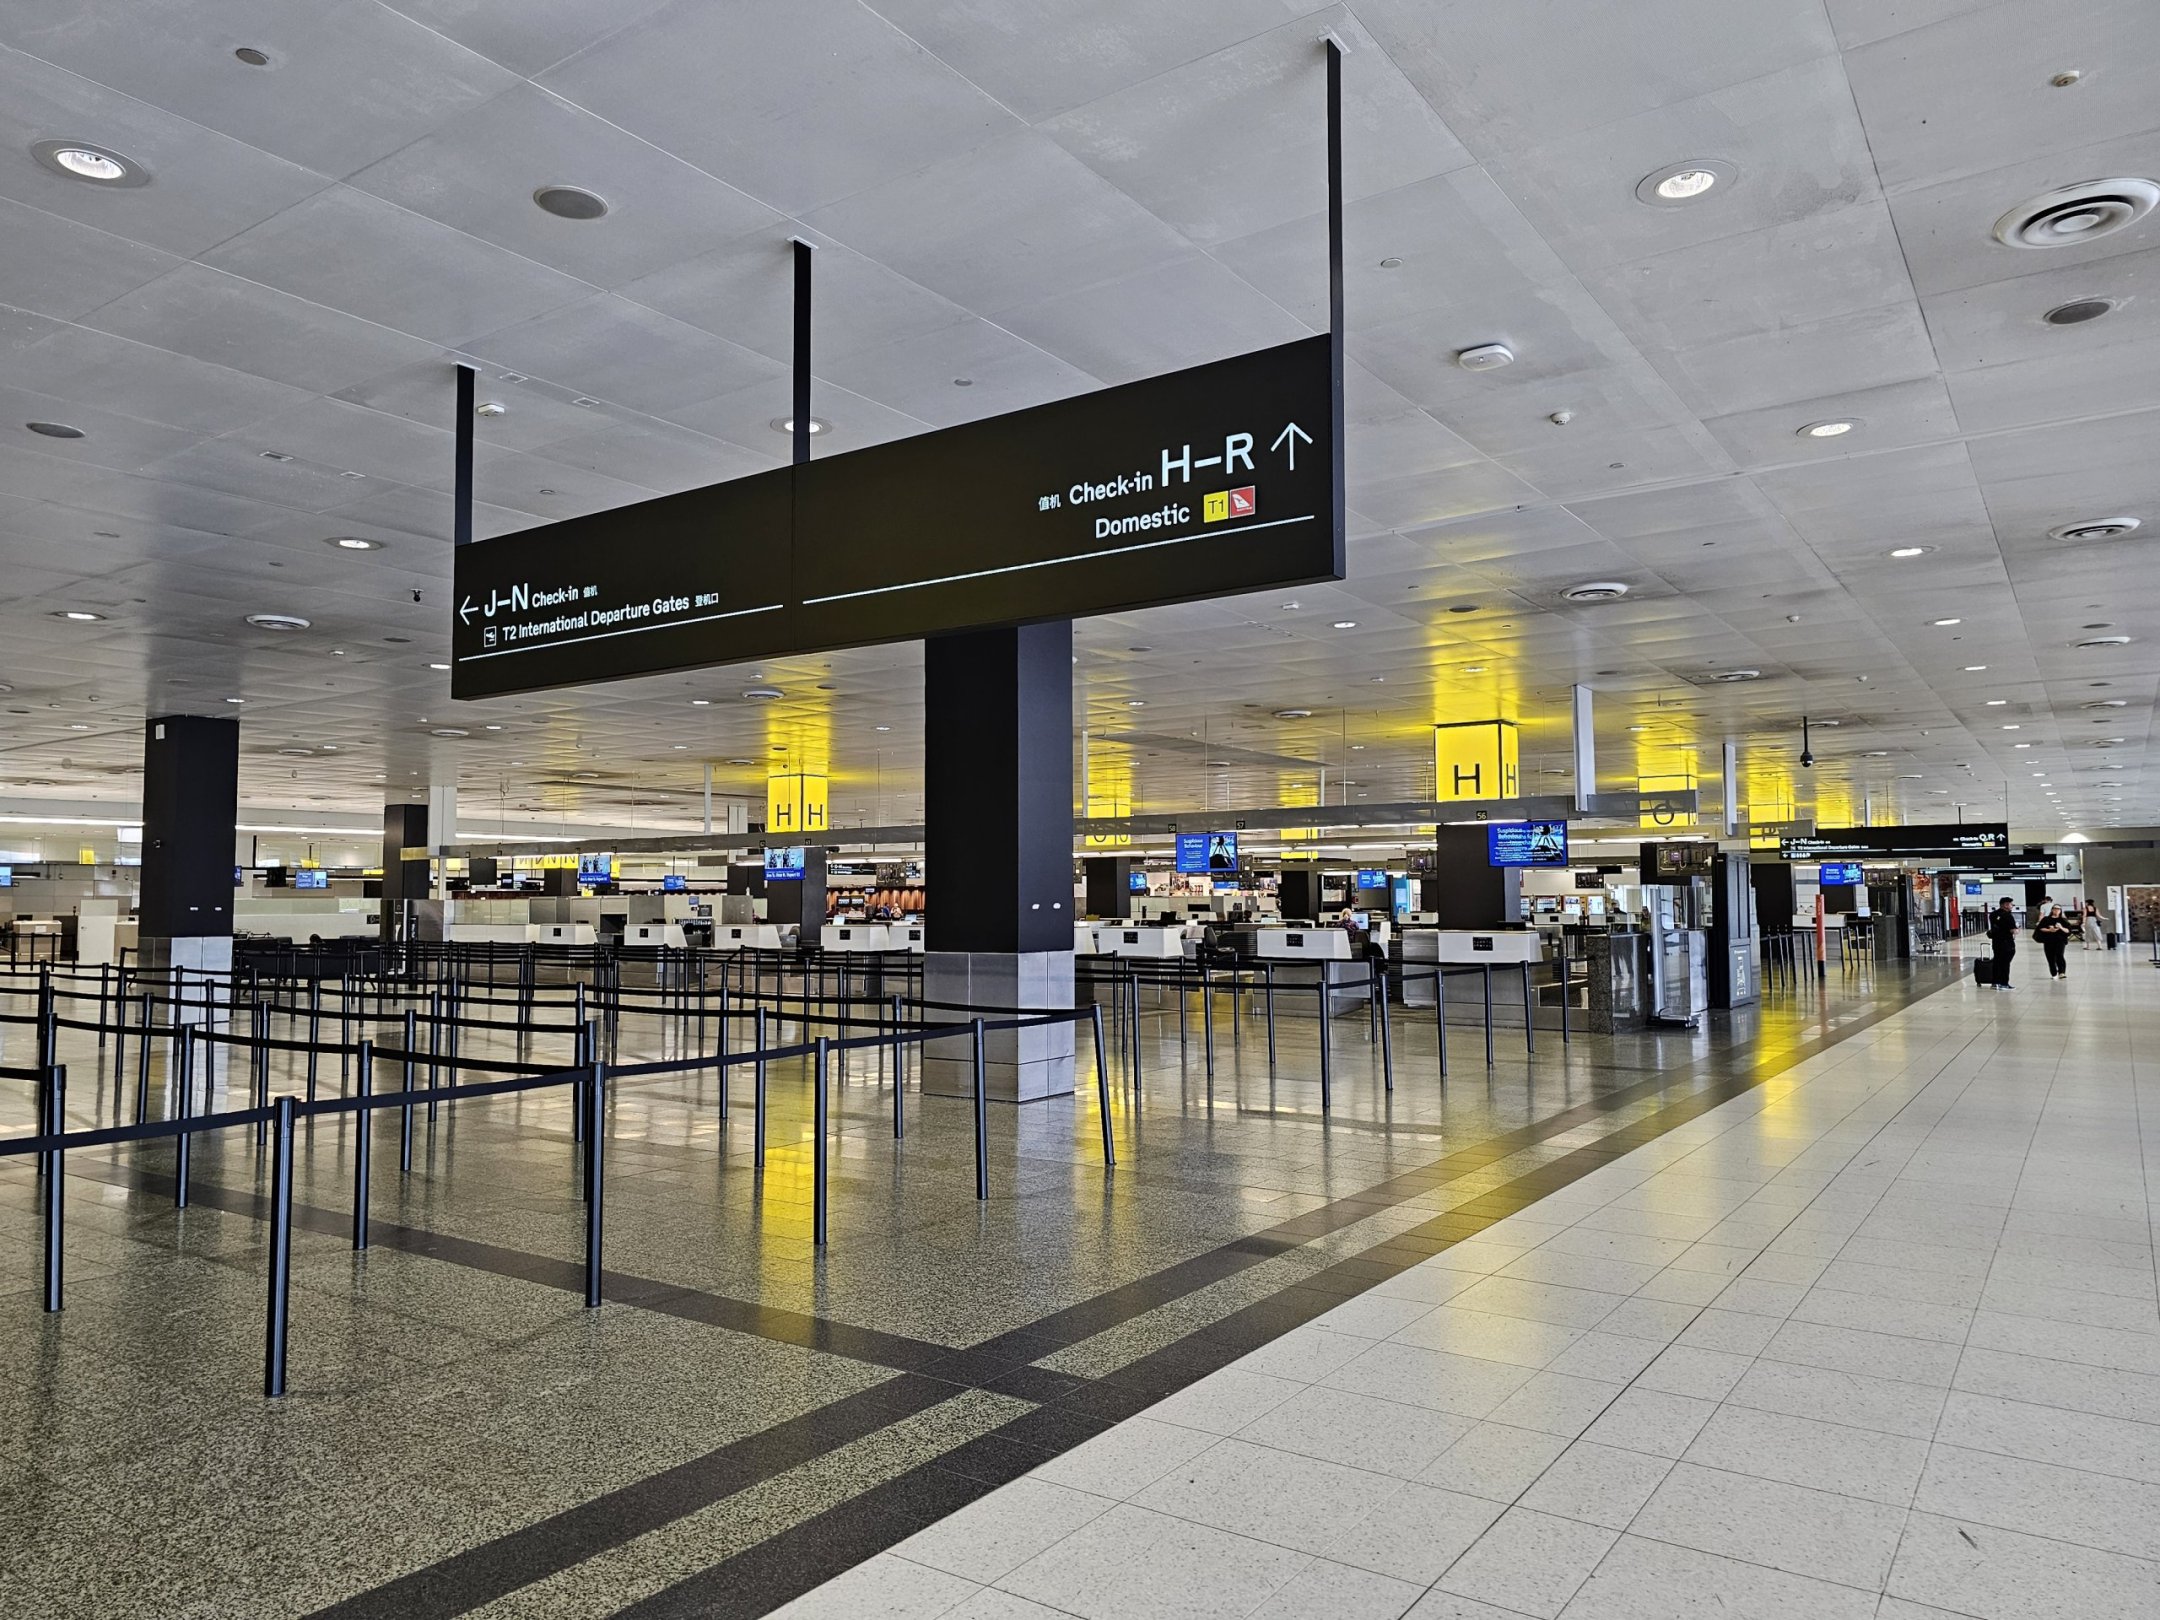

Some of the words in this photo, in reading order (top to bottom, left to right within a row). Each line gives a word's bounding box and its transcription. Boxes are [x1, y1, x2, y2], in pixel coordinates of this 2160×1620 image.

[1069, 470, 1153, 505] Check-in
[1095, 503, 1190, 539] Domestic
[1208, 499, 1225, 515] T1
[532, 585, 579, 609] Check-in
[502, 625, 517, 642] T2
[518, 611, 588, 639] International
[591, 603, 650, 627] Departure
[652, 594, 690, 614] Gates
[1454, 763, 1481, 796] H
[1505, 763, 1517, 795] H
[776, 803, 792, 827] H
[808, 803, 823, 827] H
[1477, 812, 1487, 820] 56
